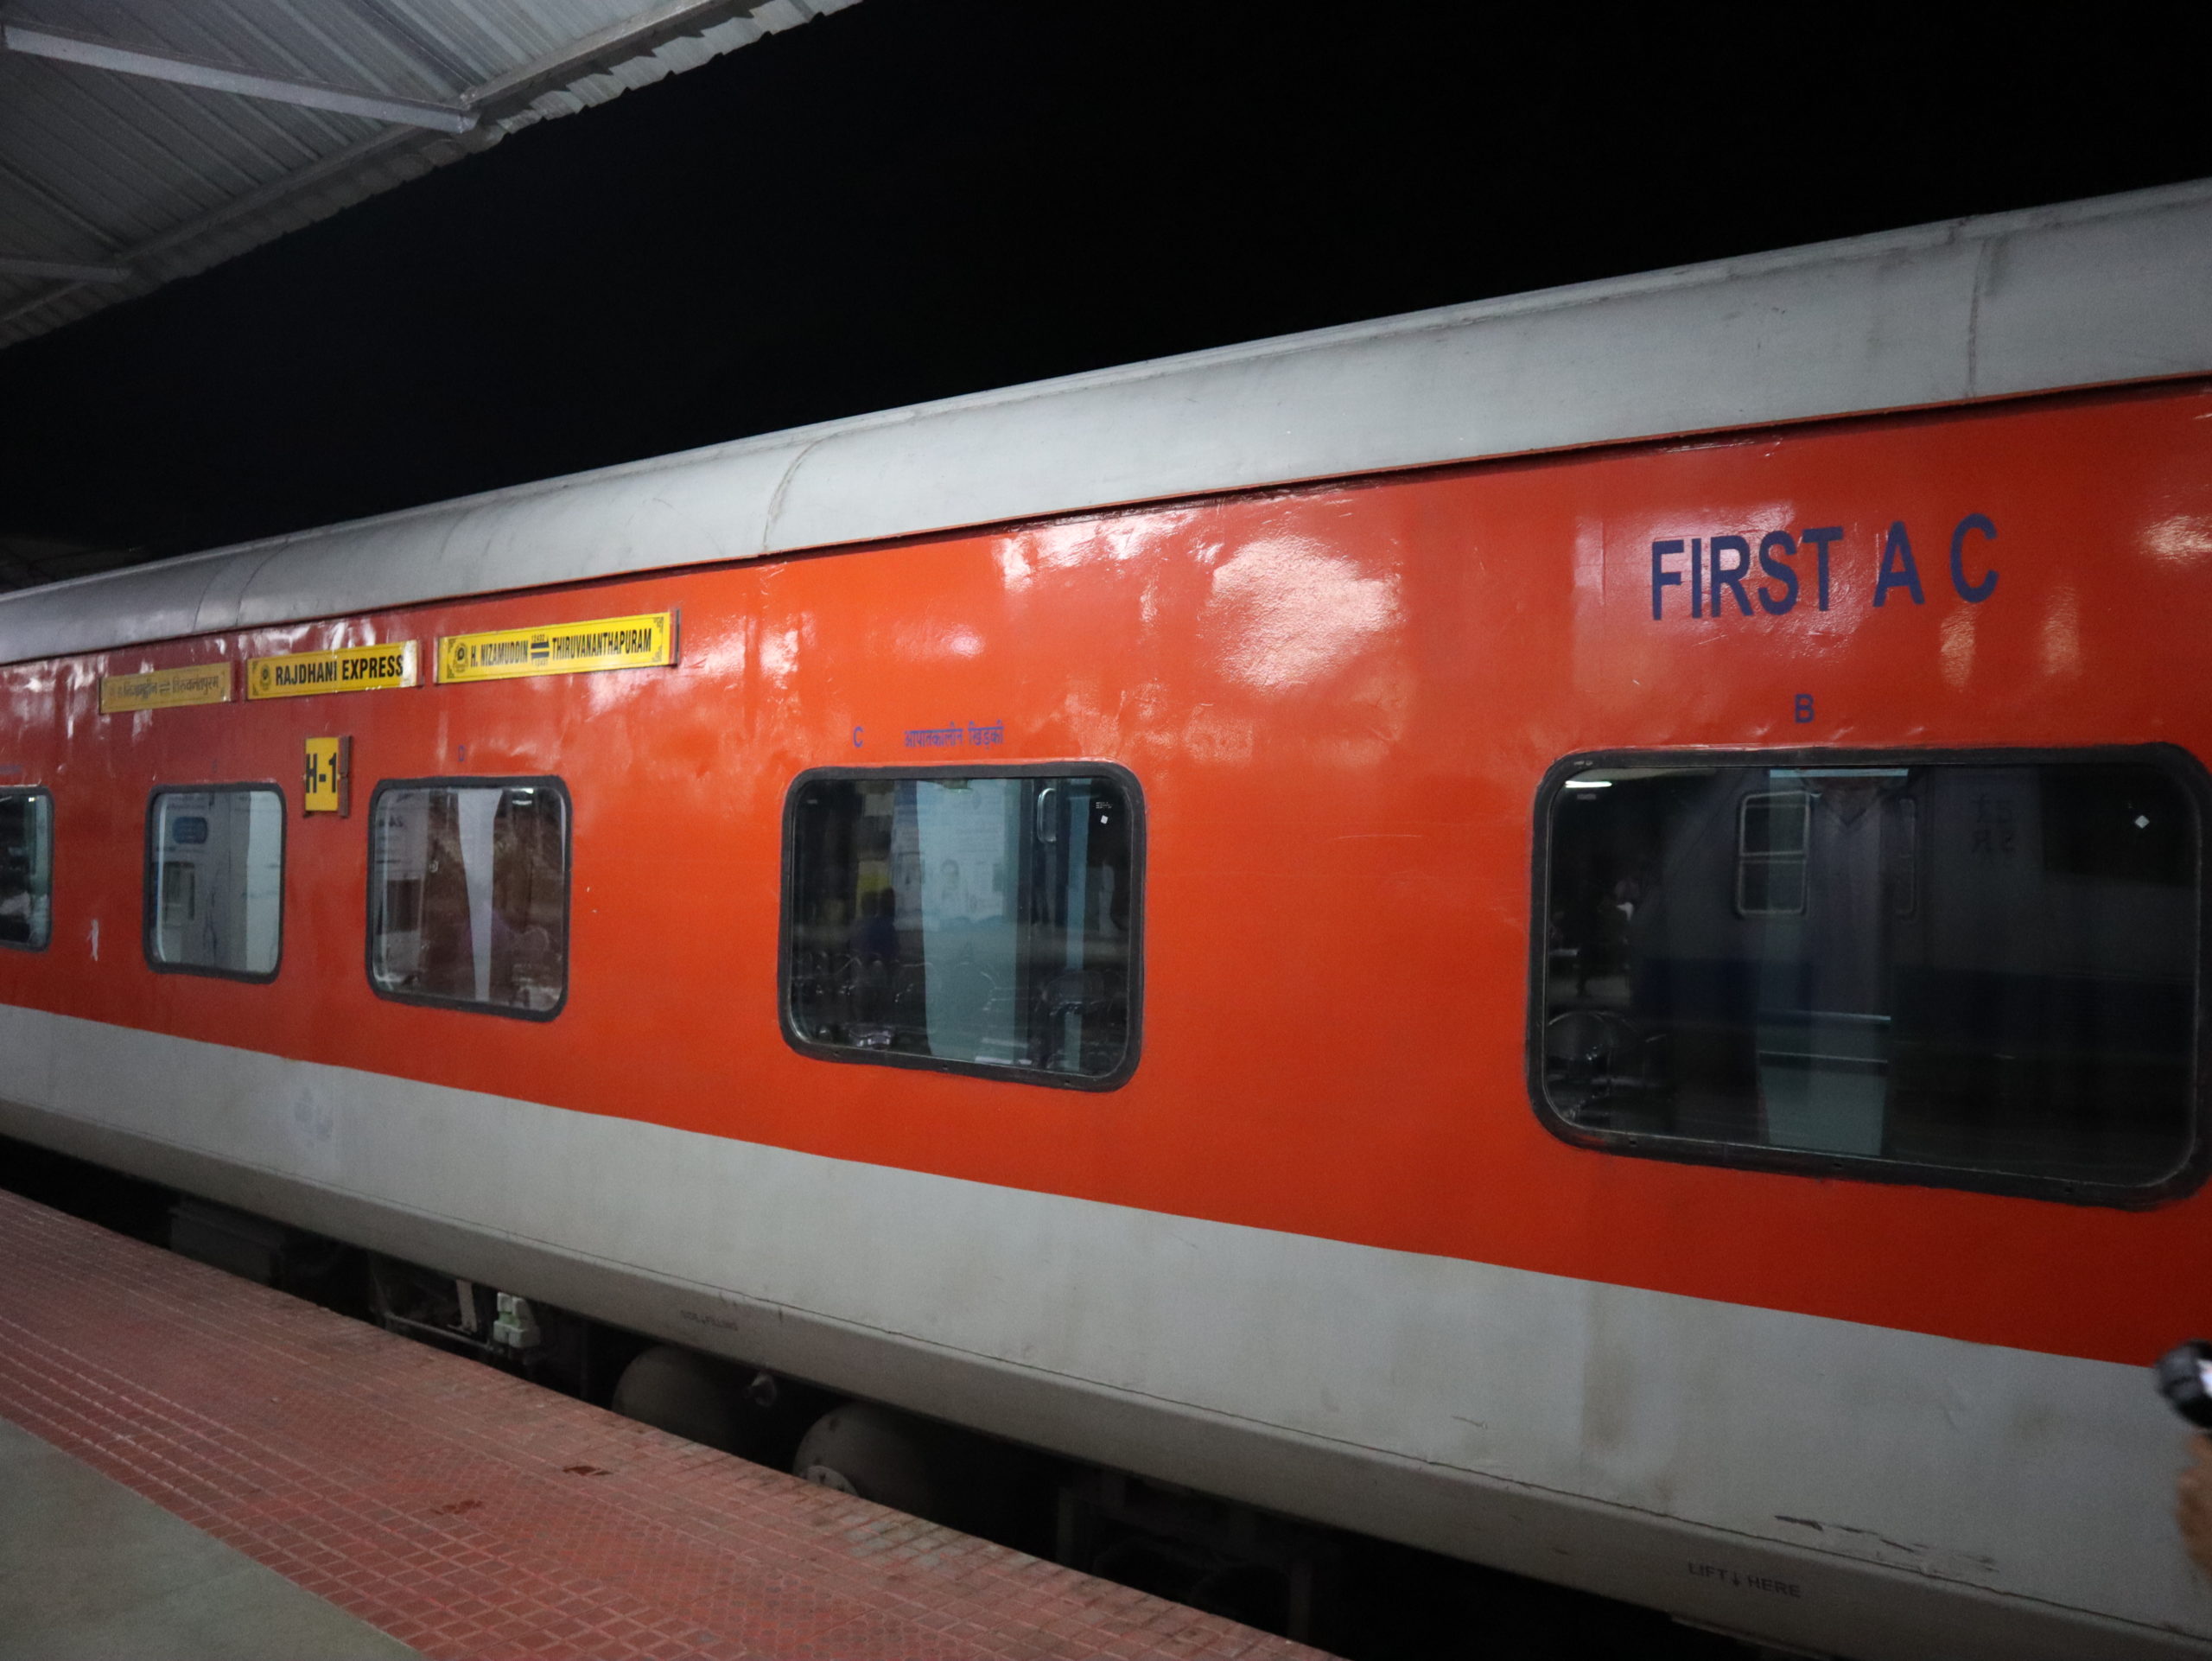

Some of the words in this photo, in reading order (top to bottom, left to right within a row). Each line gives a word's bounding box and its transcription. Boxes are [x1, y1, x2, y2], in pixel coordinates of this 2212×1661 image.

[1650, 525, 1845, 620] FIRST
[1872, 520, 1925, 608] A
[1949, 512, 1999, 603] C
[480, 640, 529, 666] NIZAMUDDIN
[552, 628, 652, 660] THIRUVANANTHAPURAM
[276, 660, 337, 686] RAJDHANI
[342, 654, 404, 681] EXPRESS
[1794, 693, 1814, 723] B
[853, 726, 864, 748] C
[305, 752, 337, 793] H-1
[1688, 1562, 1728, 1581] LIFT
[1747, 1575, 1801, 1599] HERE
